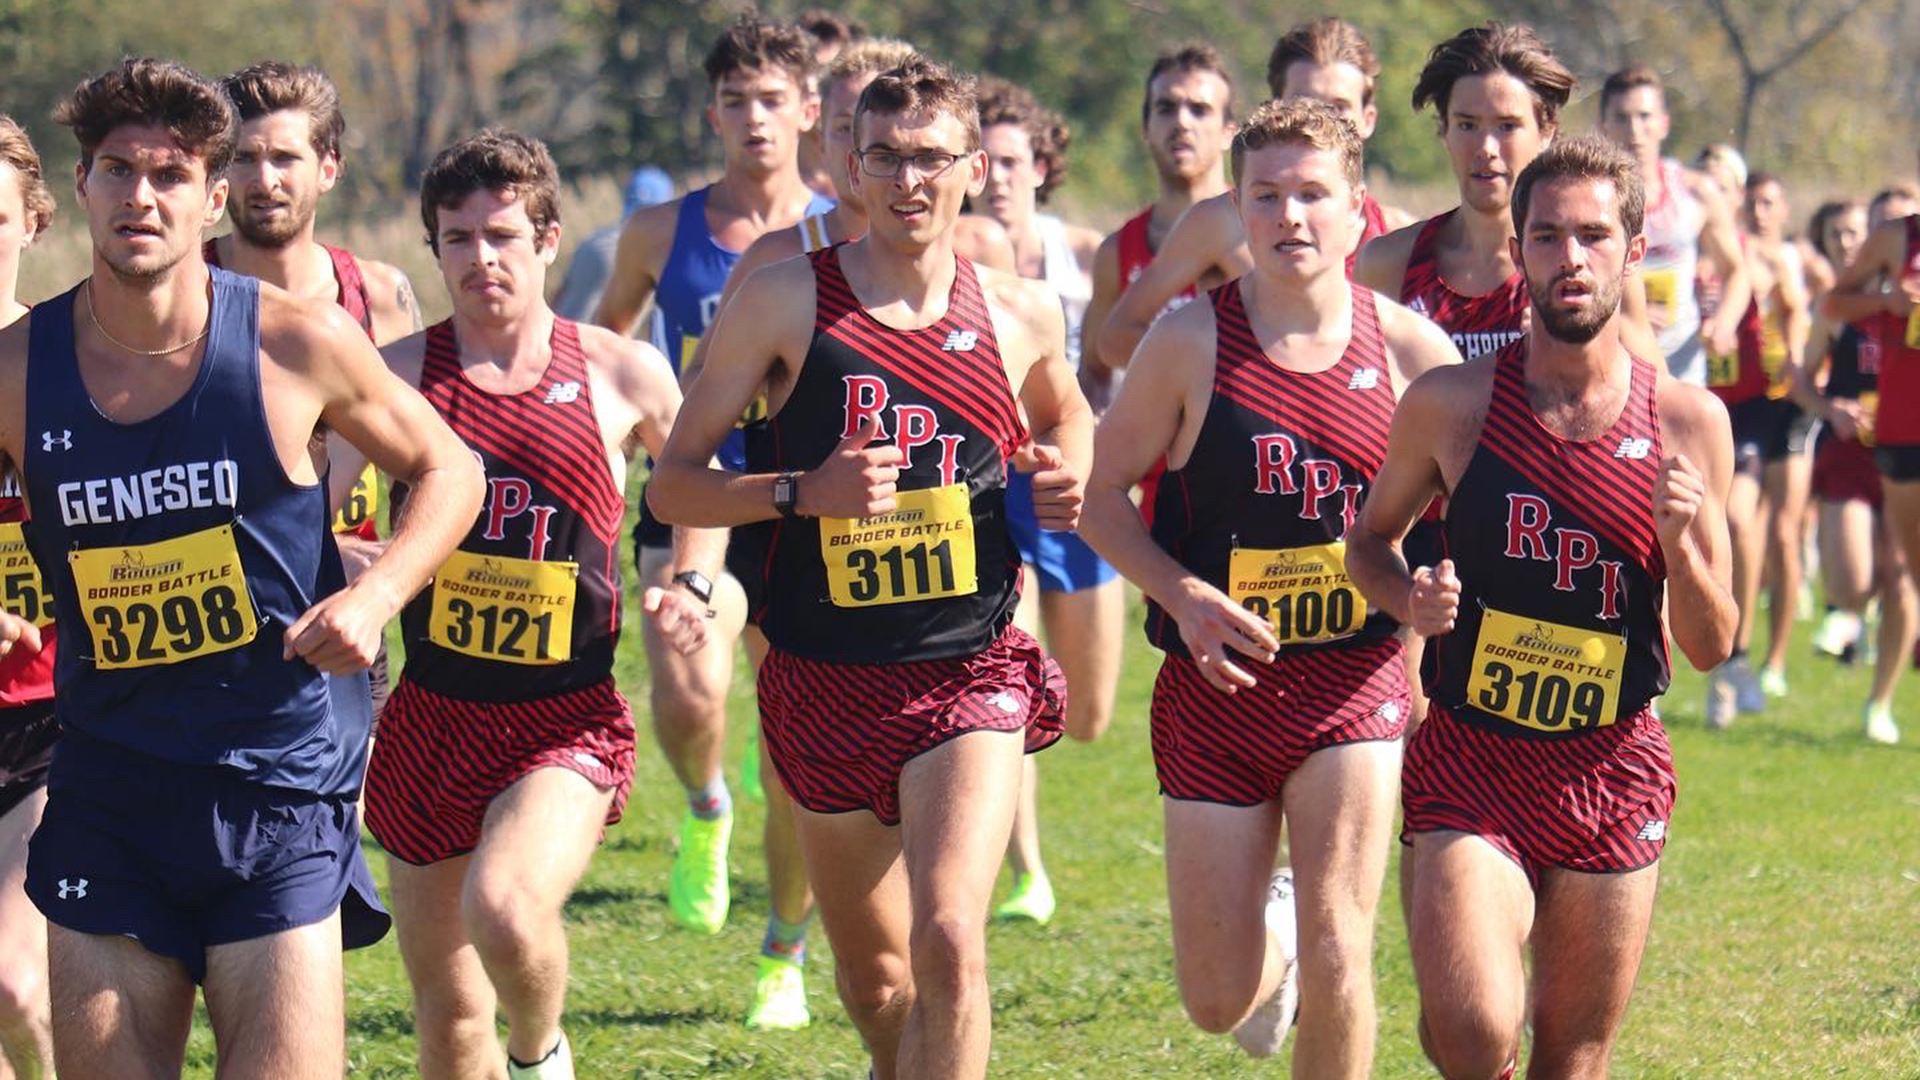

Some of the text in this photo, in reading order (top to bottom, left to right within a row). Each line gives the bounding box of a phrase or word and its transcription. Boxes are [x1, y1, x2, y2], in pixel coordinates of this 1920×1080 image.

[840, 375, 966, 487] RPI
[58, 460, 238, 526] GENESEO
[474, 452, 556, 561] PI
[1251, 433, 1363, 541] RPI
[830, 520, 964, 547] BORDER BATTLE
[1504, 493, 1622, 619] RPI
[88, 564, 232, 600] BORDER BATTLE
[111, 560, 184, 582] Rowan
[441, 579, 567, 606] BORDER BATTLE
[846, 540, 955, 602] 3111
[1237, 573, 1350, 592] BORDER BATTL
[93, 585, 244, 663] 3298
[447, 598, 553, 660] 3121
[1484, 643, 1616, 680] BORDER BATTLE
[1479, 661, 1605, 731] 3109
